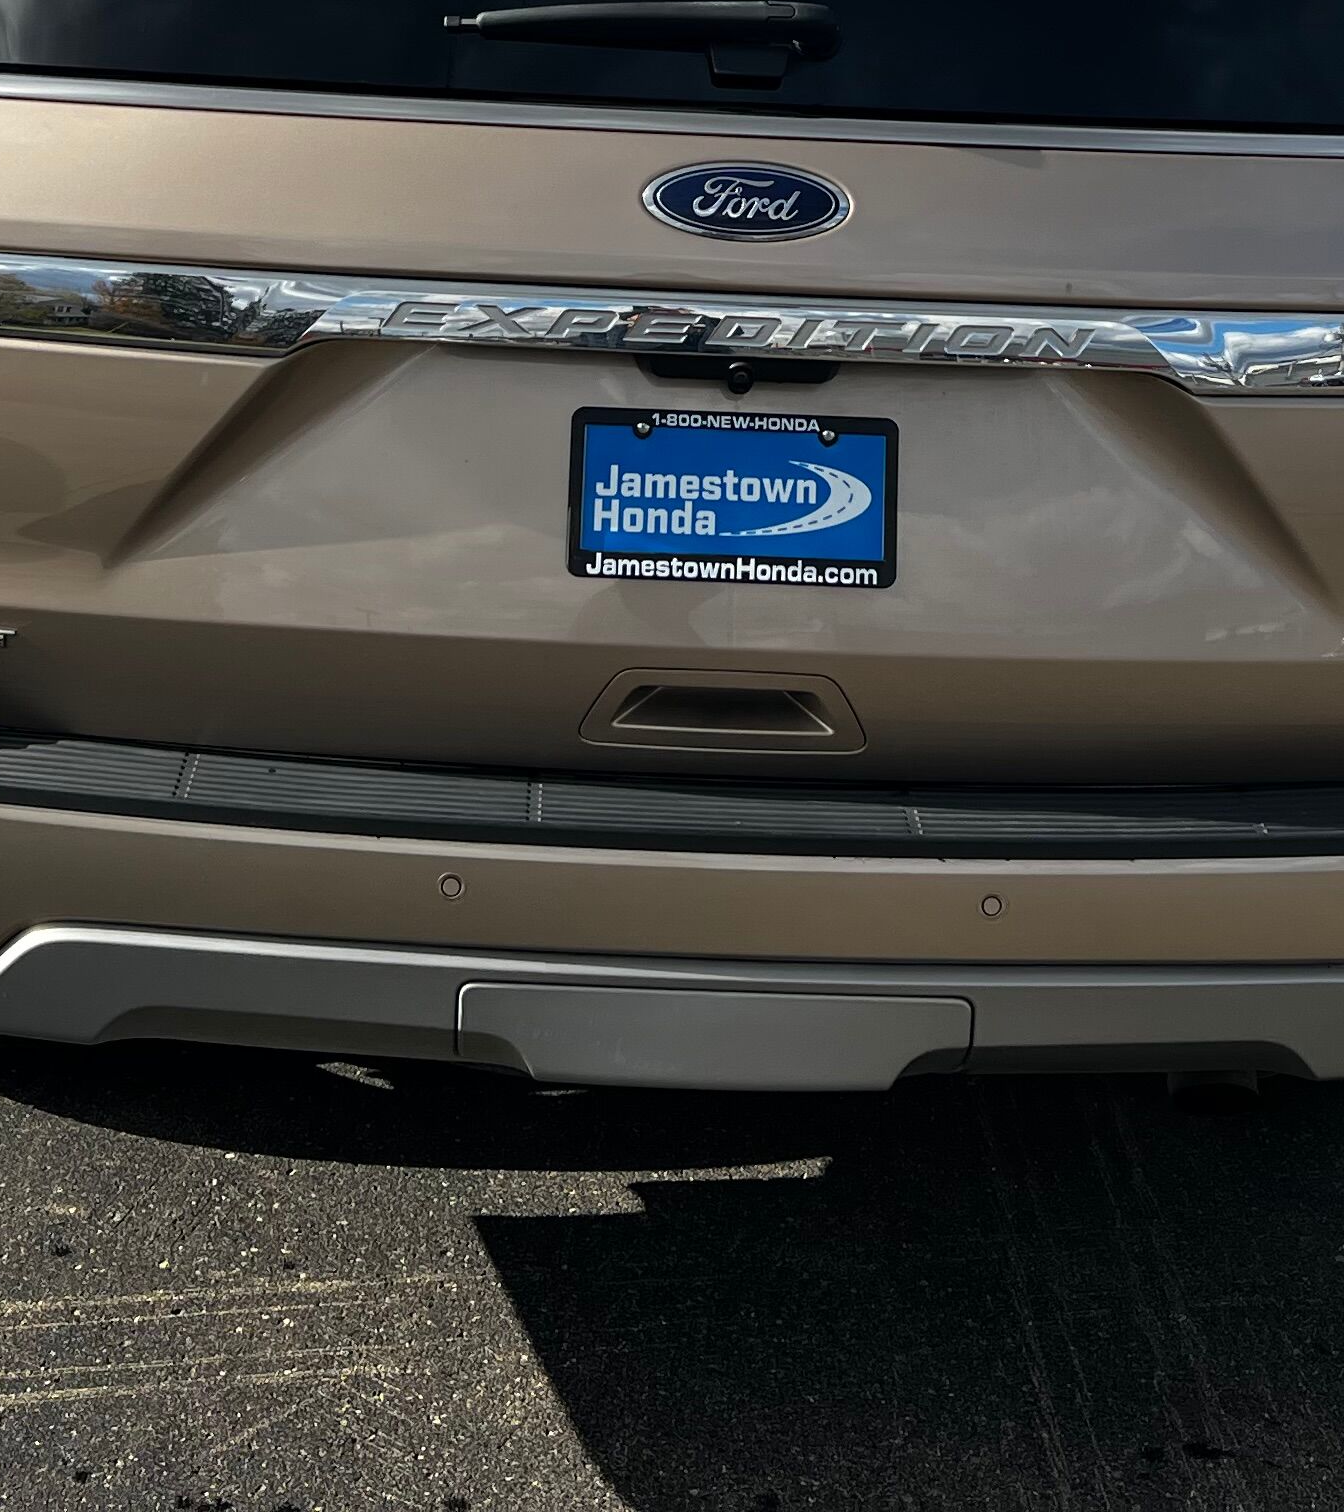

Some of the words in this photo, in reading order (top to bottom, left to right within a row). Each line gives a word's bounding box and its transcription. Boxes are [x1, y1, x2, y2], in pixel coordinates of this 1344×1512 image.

[692, 176, 801, 221] Ford
[380, 301, 1100, 358] EXPEDITION
[651, 412, 821, 433] 1-800-NEW-HONDA
[595, 464, 817, 505] Jamestown
[593, 498, 716, 536] Honda
[586, 552, 878, 586] JamestownHonda.com
